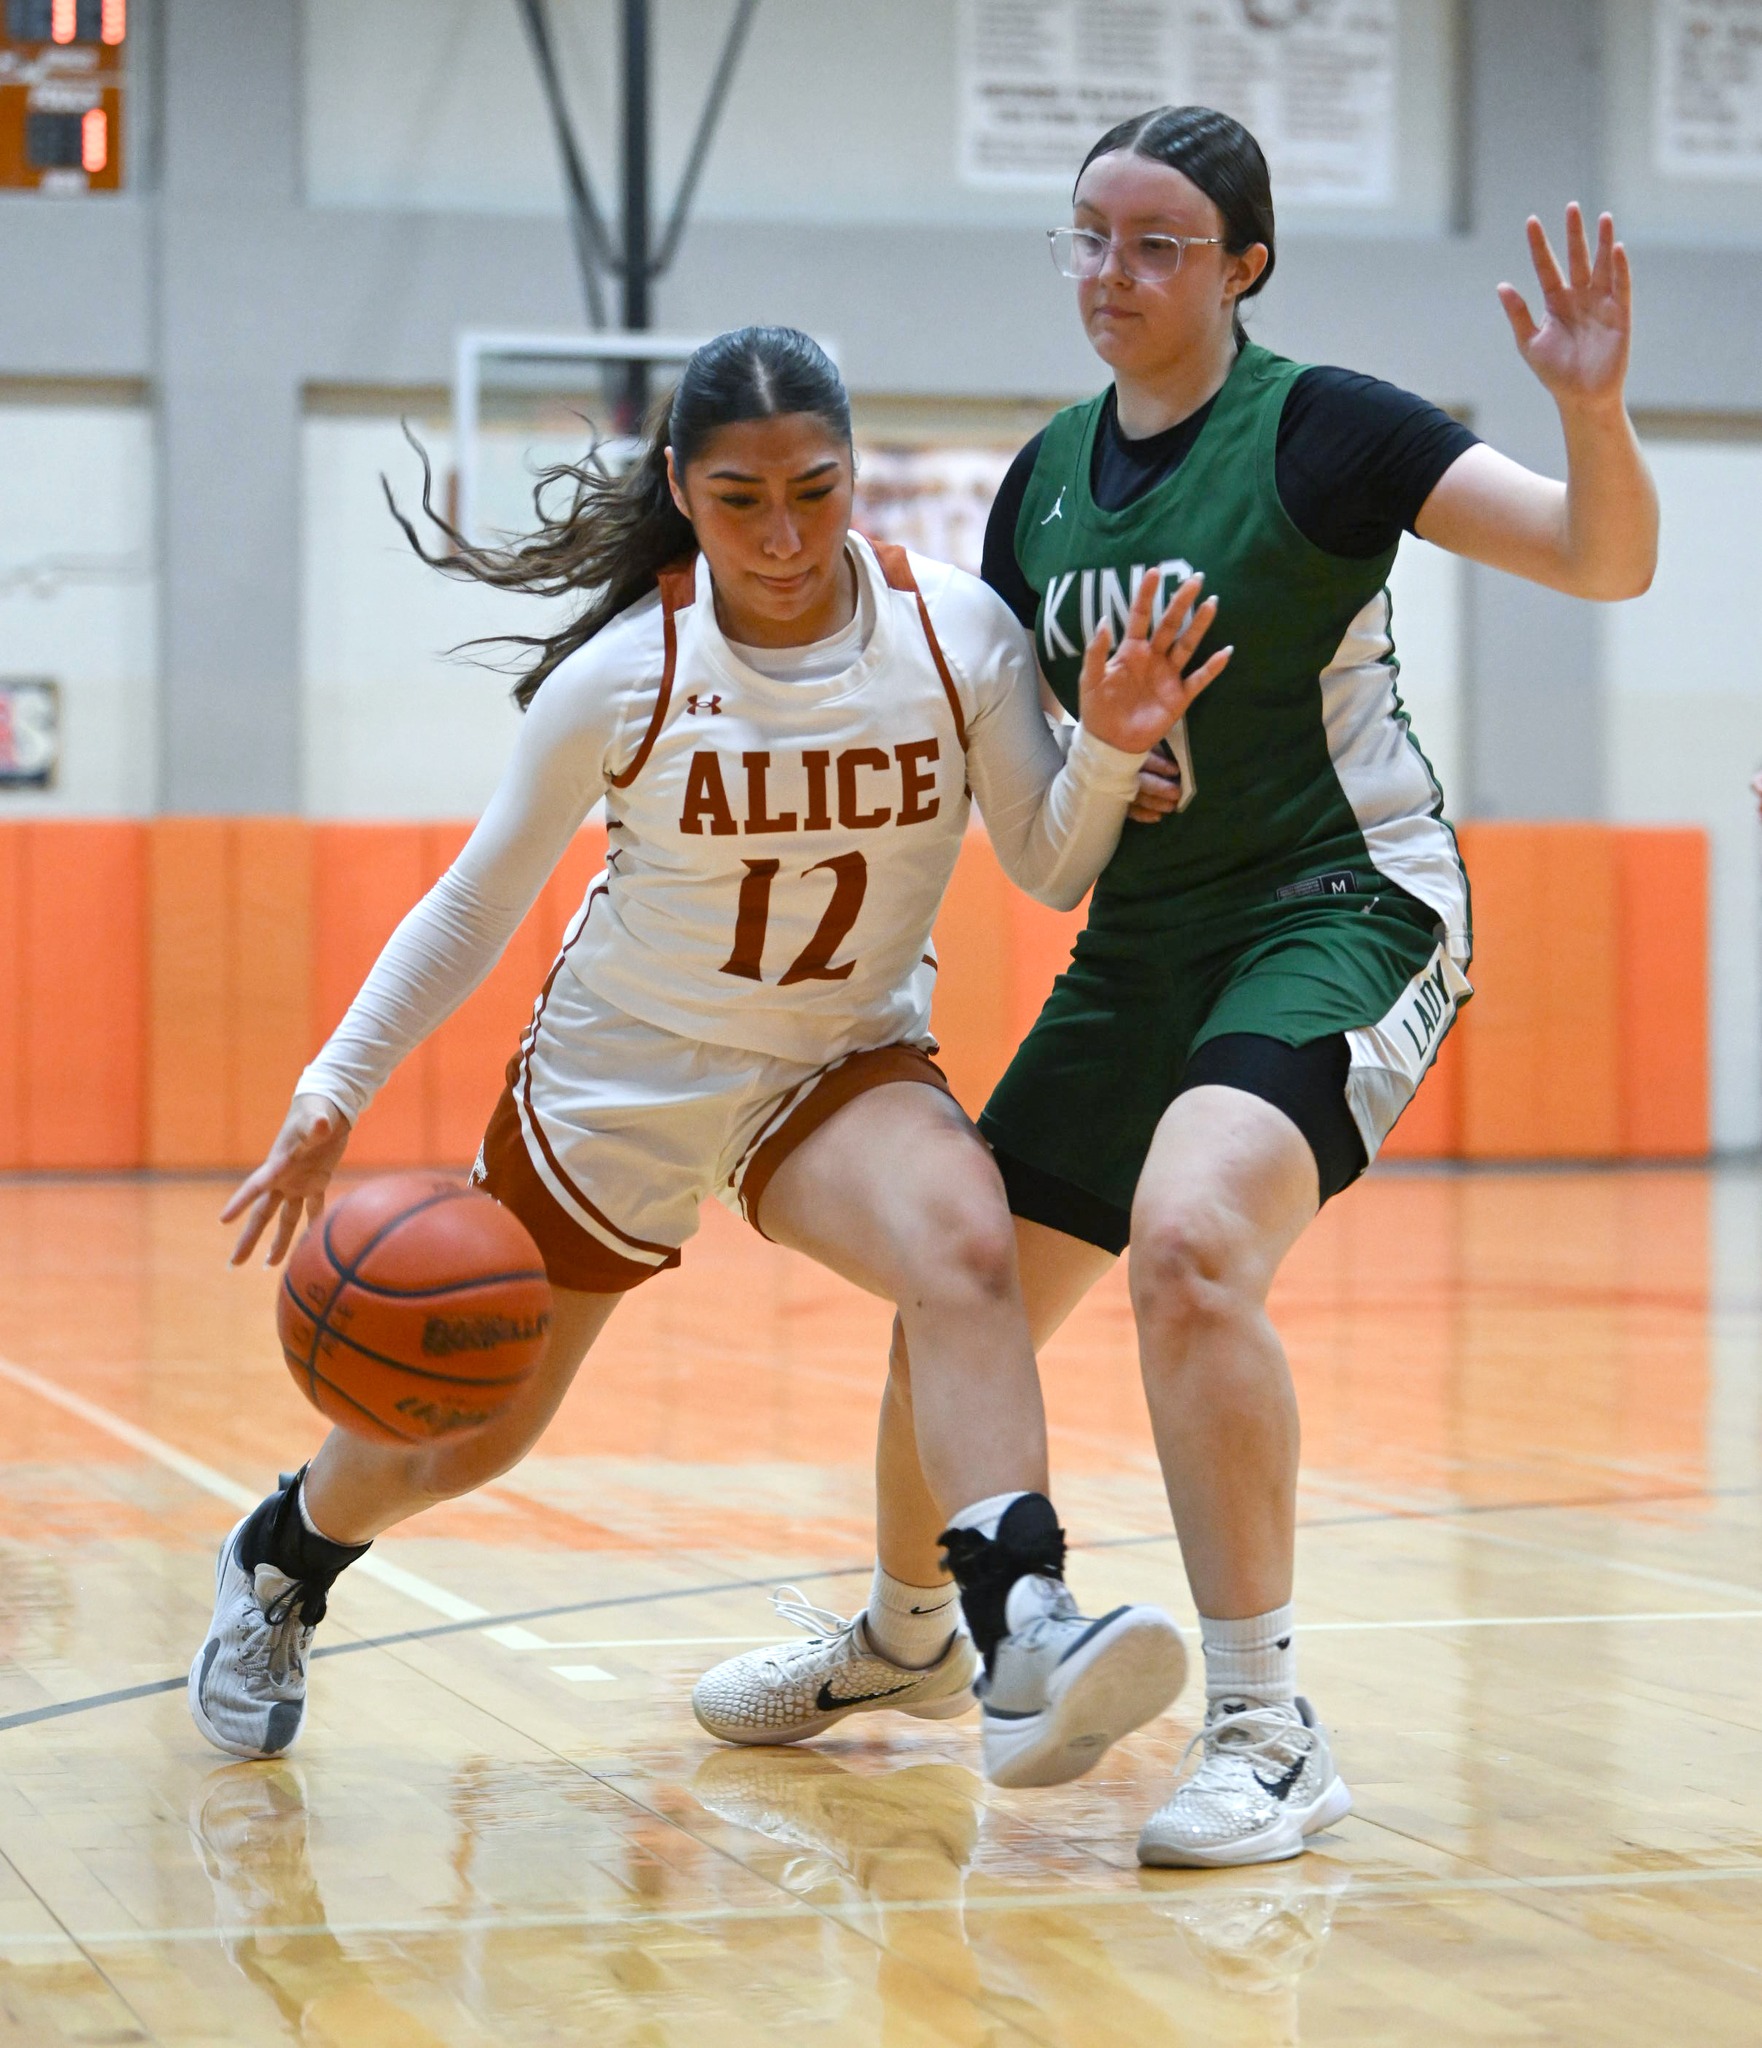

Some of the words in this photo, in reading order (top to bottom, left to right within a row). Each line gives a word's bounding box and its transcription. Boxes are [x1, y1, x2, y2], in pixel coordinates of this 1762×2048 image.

[679, 737, 941, 836] ALICE
[718, 850, 868, 986] 12
[1331, 879, 1347, 895] M
[1402, 959, 1450, 1060] LADY
